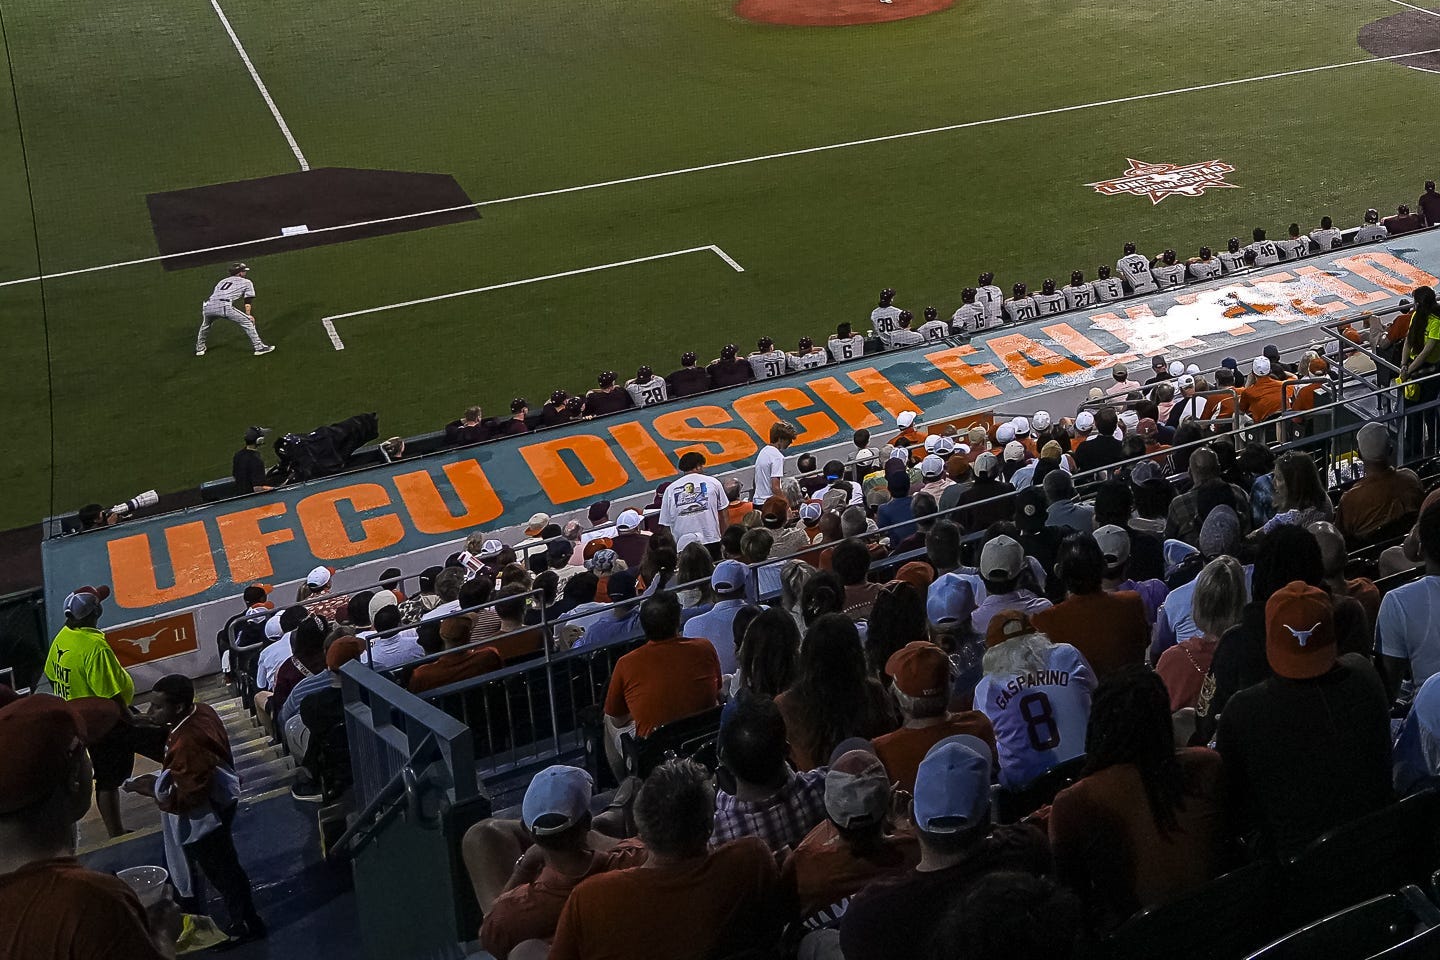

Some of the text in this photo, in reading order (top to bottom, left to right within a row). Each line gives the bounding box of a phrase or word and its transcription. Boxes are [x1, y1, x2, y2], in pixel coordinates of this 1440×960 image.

[1103, 164, 1227, 193] LONE STAR
[1260, 243, 1275, 257] 46
[1129, 261, 1147, 274] 32
[1170, 274, 1178, 285] 9
[986, 292, 993, 303] 1
[1108, 285, 1118, 297] 5
[1050, 300, 1062, 313] 41
[1075, 293, 1091, 307] 27
[1017, 307, 1034, 320] 20
[877, 317, 893, 333] 38
[974, 314, 985, 328] 15
[930, 327, 944, 339] 47
[843, 344, 853, 359] 6
[766, 361, 781, 377] 31
[642, 387, 663, 406] 28
[107, 457, 504, 609] UFCU
[173, 627, 187, 642] 11
[996, 670, 1069, 710] GASPARINO
[1019, 691, 1061, 751] 8
